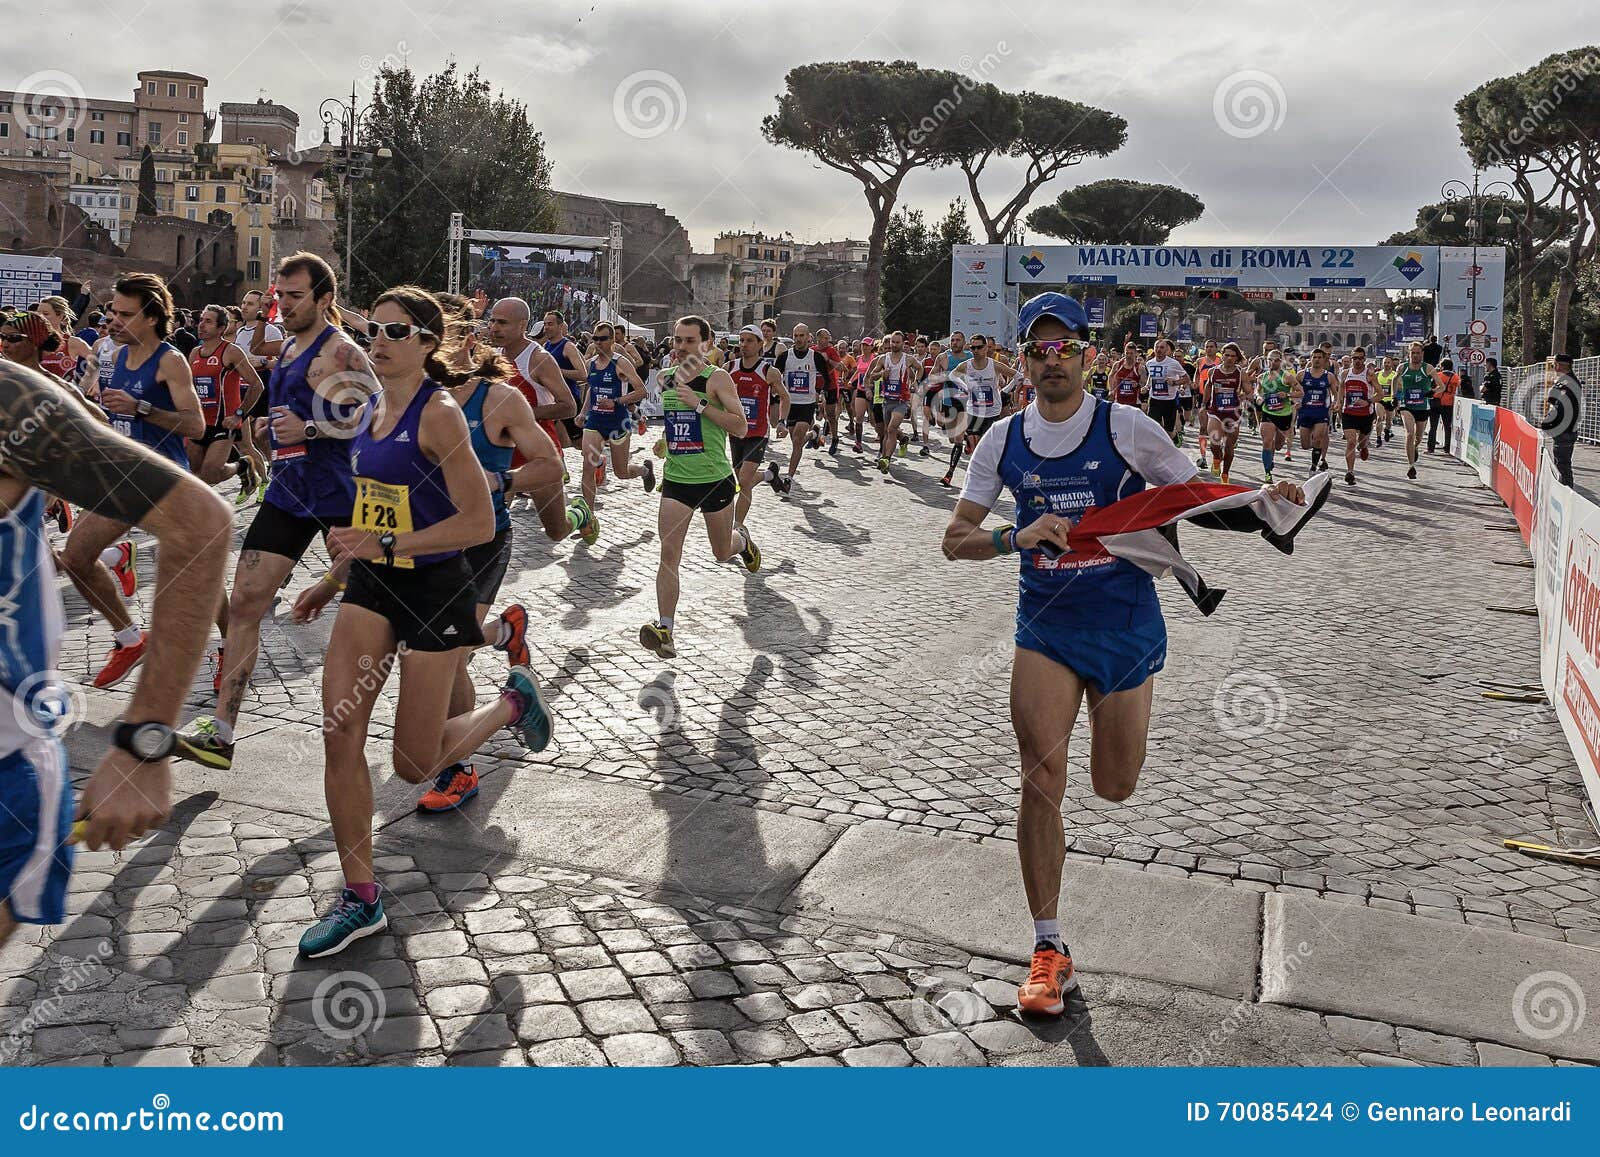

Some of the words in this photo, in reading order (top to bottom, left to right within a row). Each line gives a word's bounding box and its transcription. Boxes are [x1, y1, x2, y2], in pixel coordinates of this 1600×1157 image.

[1078, 249, 1202, 267] MARATONA
[1210, 248, 1232, 267] di
[1242, 249, 1312, 267] ROMA
[1322, 249, 1354, 267] 22
[1246, 291, 1272, 299] TIMEX
[1472, 353, 1481, 361] 30
[673, 423, 690, 436] 172
[1069, 478, 1090, 486] ROMA
[1049, 490, 1094, 503] MARATONA
[1060, 500, 1085, 510] ROMA
[362, 503, 369, 525] F
[374, 504, 398, 528] 28
[1061, 561, 1077, 569] new
[1079, 556, 1113, 568] balance
